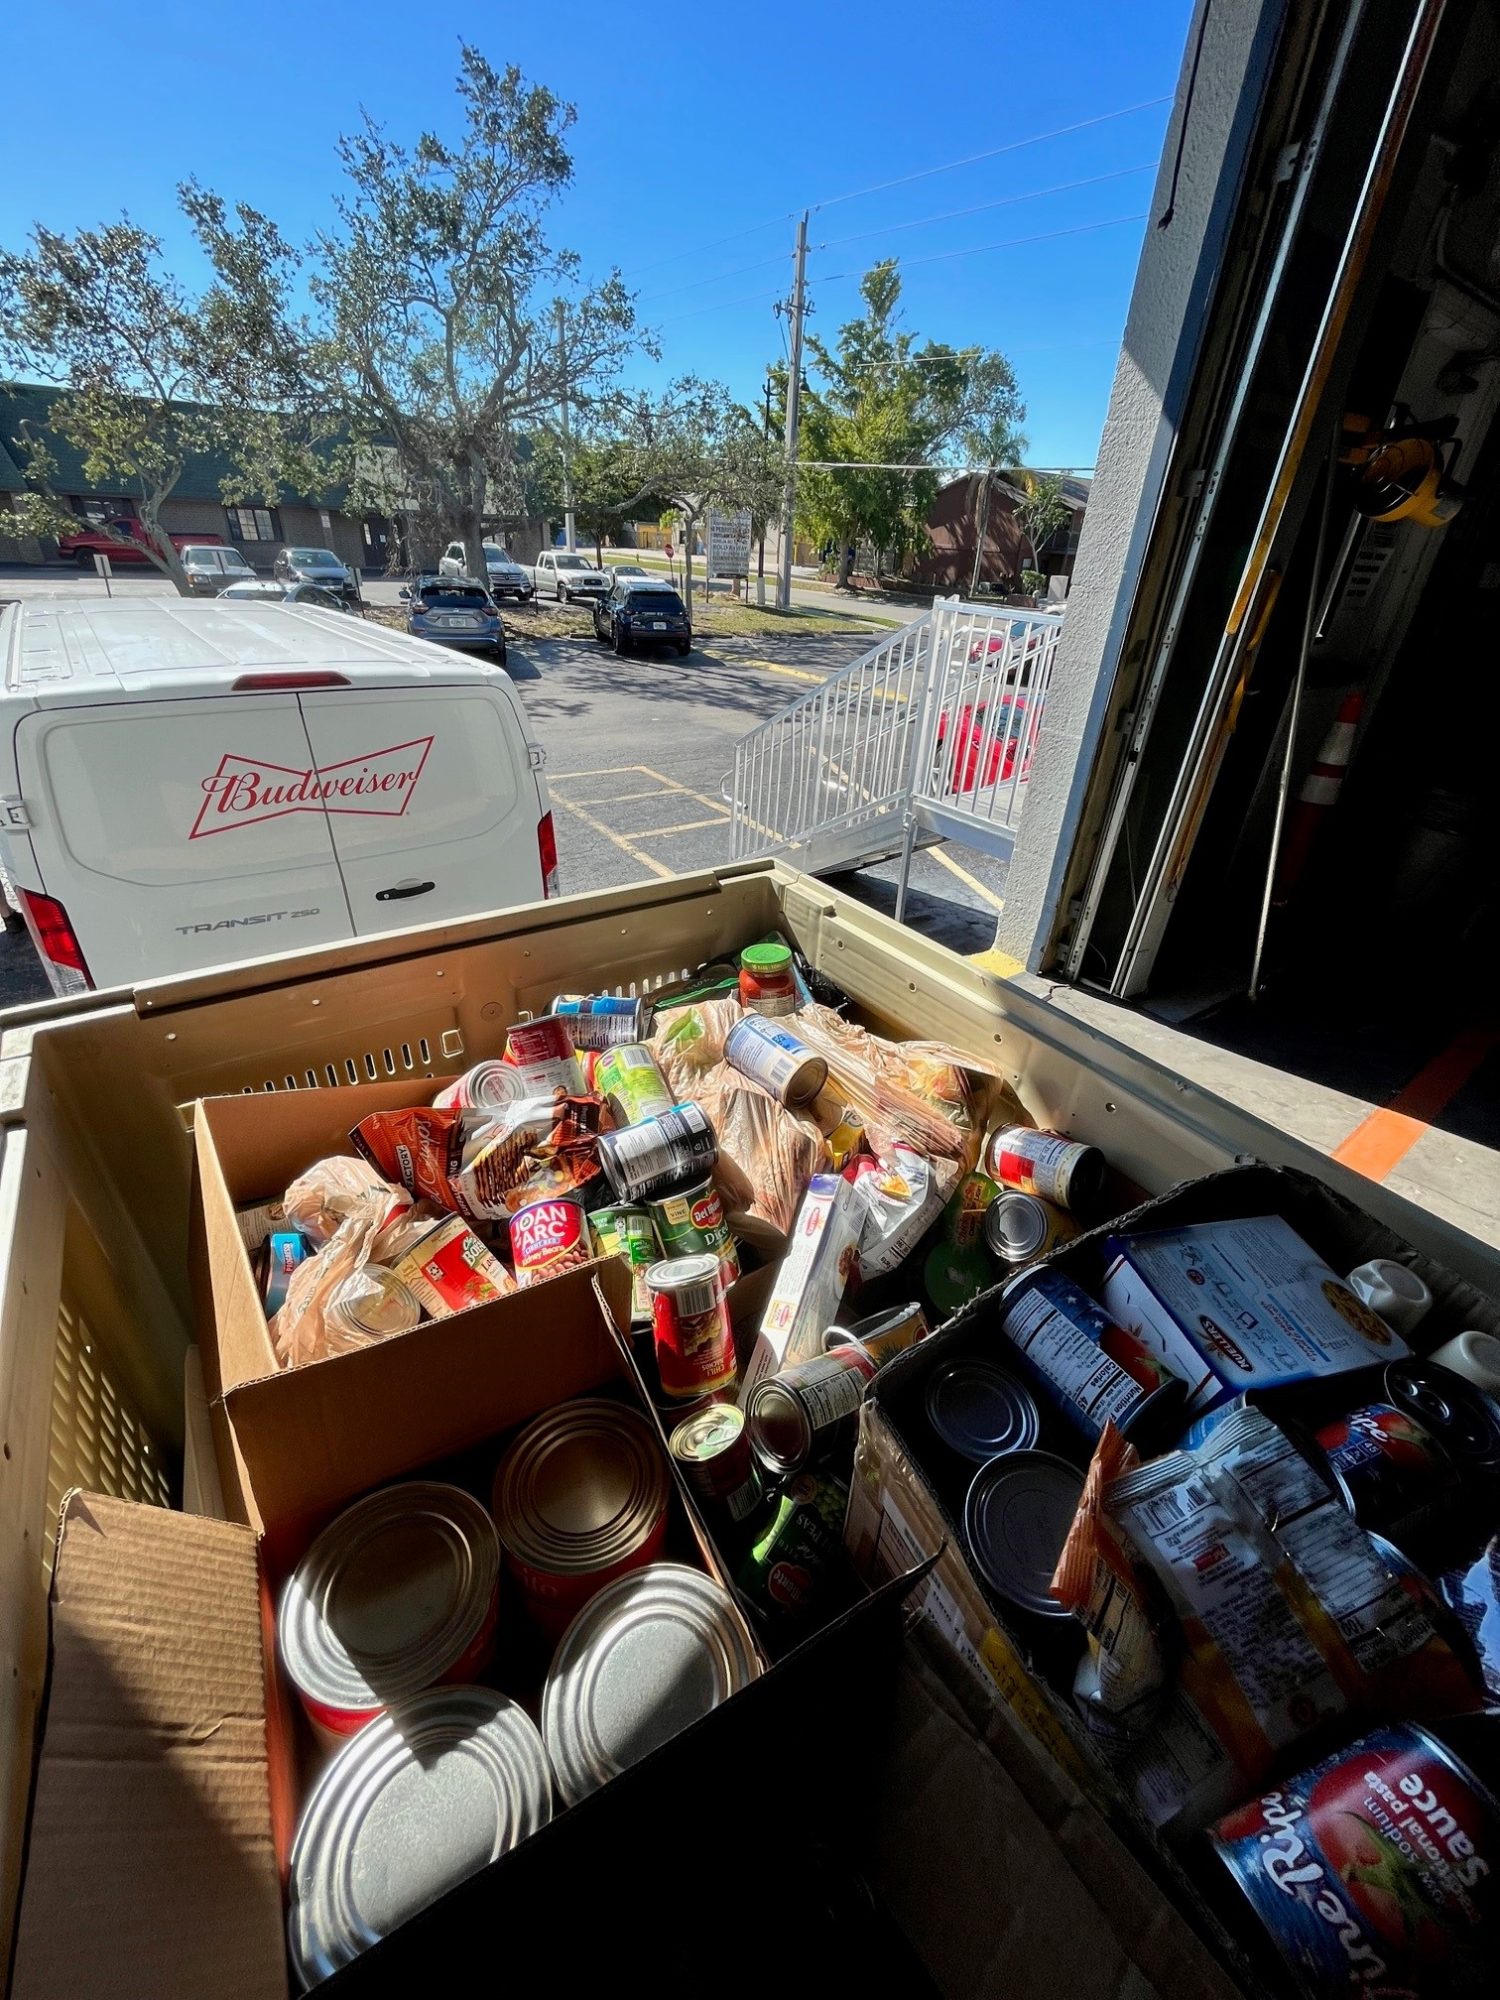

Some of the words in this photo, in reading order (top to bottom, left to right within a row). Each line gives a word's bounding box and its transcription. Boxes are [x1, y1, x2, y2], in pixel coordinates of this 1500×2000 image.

[202, 768, 417, 813] Budweiser
[176, 911, 288, 935] TRANSIT
[291, 908, 320, 918] 250
[398, 1146, 414, 1187] FACTORY
[513, 1205, 567, 1240] JOAN
[521, 1221, 566, 1247] ARC
[1199, 1317, 1251, 1369] MUELLERS
[1089, 1361, 1116, 1386] Calories
[1077, 1397, 1090, 1410] 45
[1113, 1385, 1142, 1415] Nutrition
[1364, 1771, 1409, 1816] pasta
[1261, 1792, 1323, 1897] Ripe
[1363, 1797, 1419, 1864] sodium
[1400, 1773, 1490, 1888] Sauce
